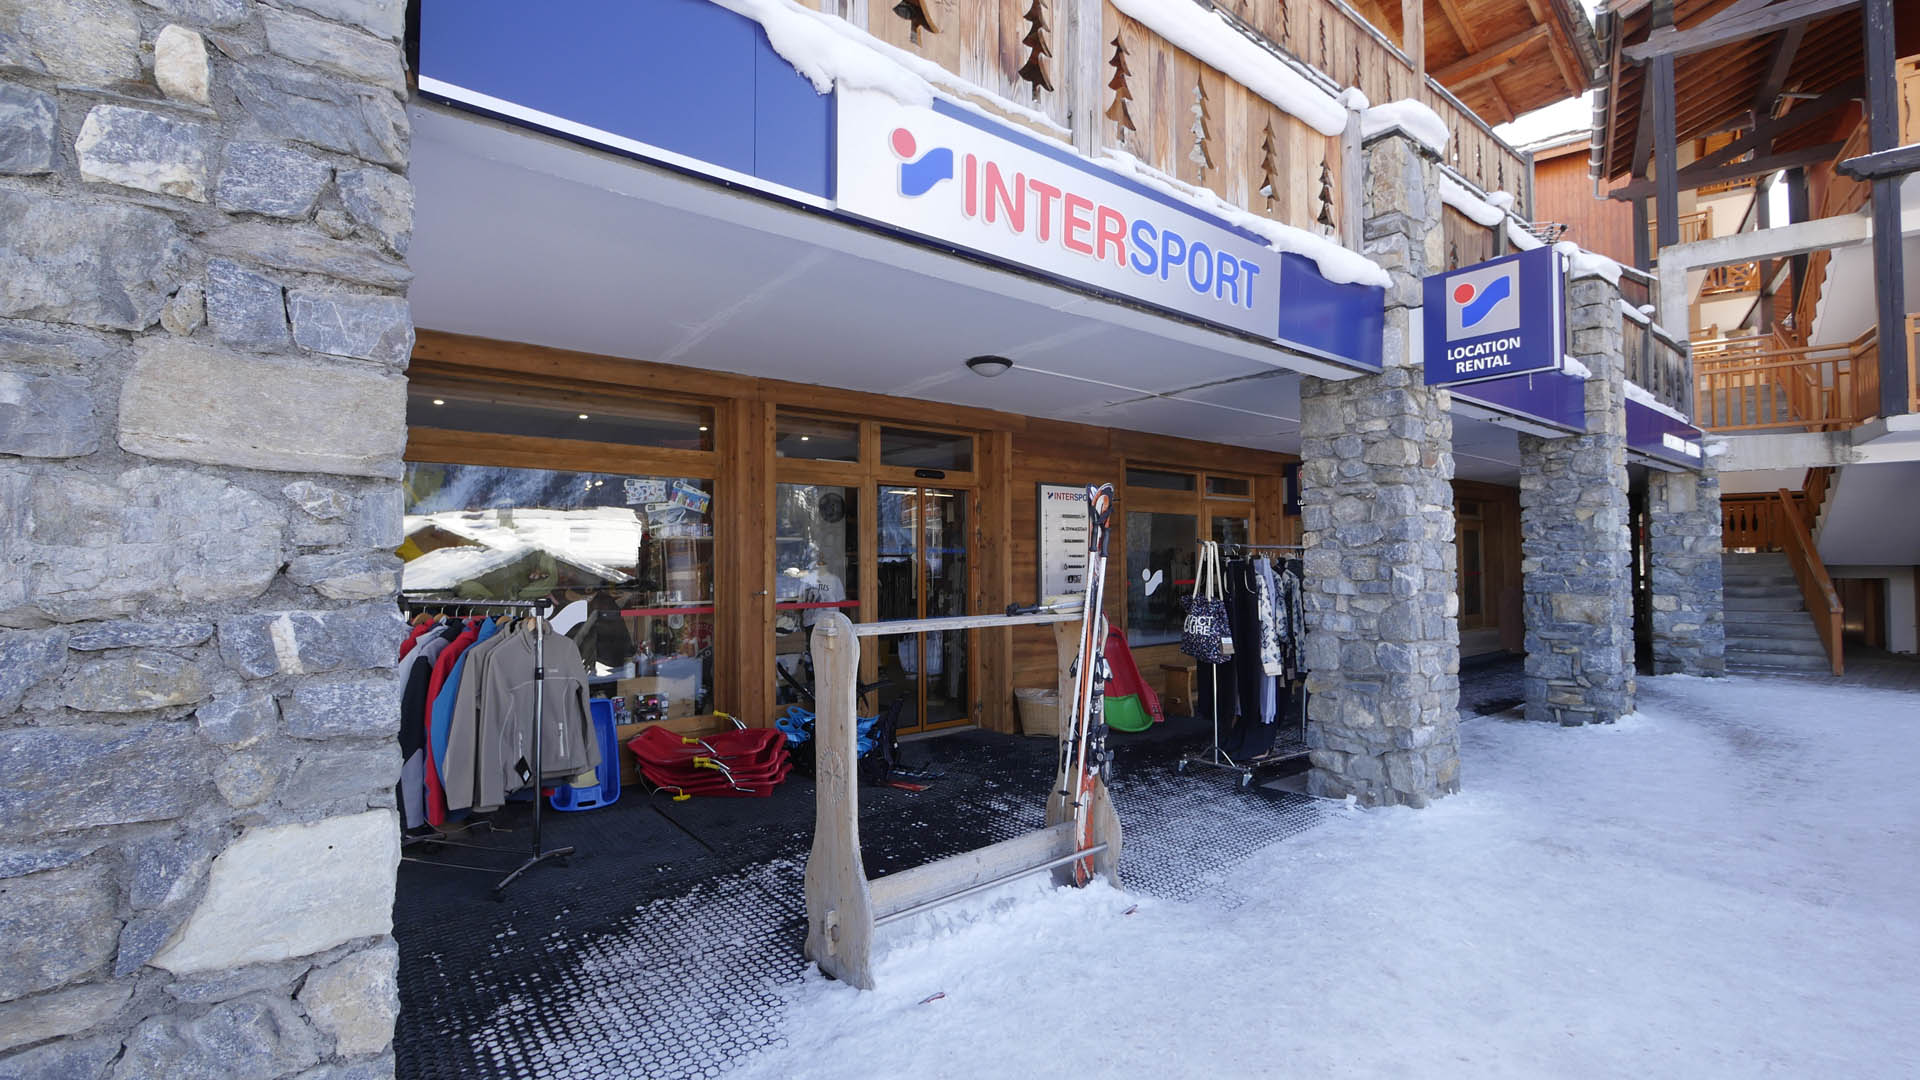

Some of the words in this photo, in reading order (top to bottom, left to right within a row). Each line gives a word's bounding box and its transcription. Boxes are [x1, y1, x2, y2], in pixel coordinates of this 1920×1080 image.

[964, 153, 1260, 310] INTERSPORT
[1447, 336, 1521, 361] LOCATION
[1455, 354, 1511, 374] RENTAL
[1054, 491, 1088, 502] INTERSPO
